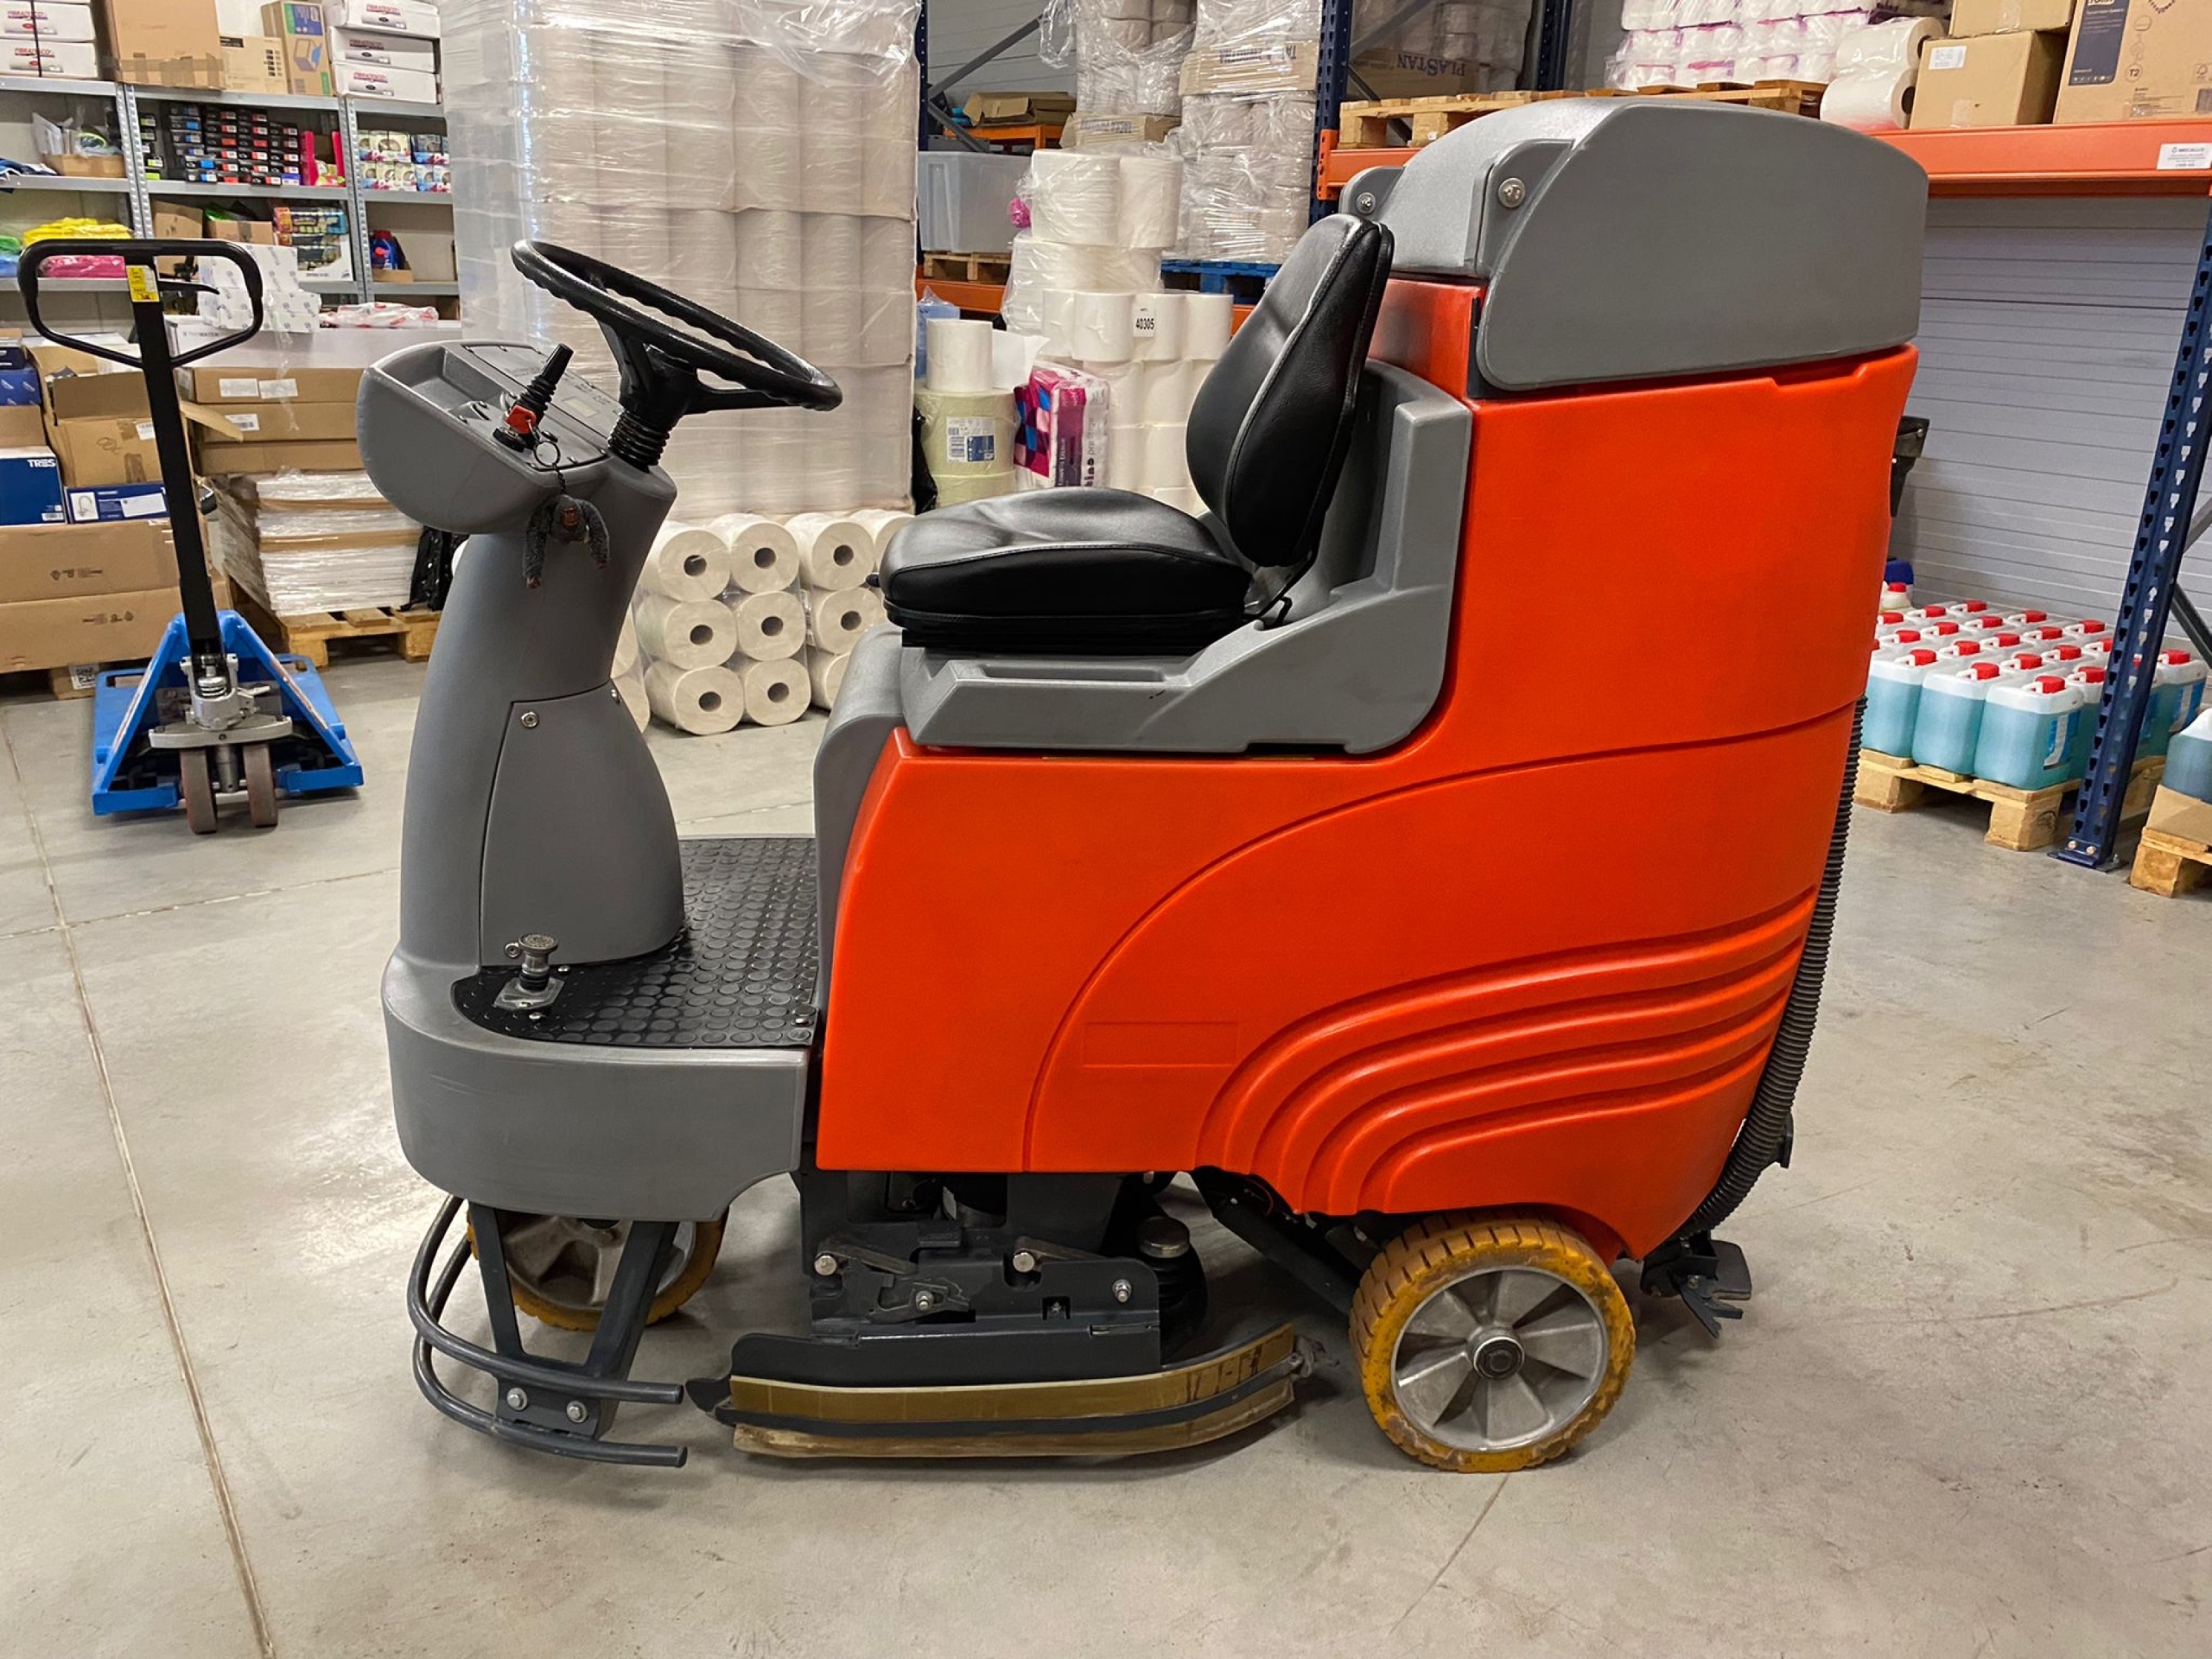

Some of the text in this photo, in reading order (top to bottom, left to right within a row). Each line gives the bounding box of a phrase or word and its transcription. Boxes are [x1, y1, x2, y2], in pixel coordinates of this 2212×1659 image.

[1396, 54, 1466, 77] PLASTAN
[2129, 68, 2140, 77] T2
[1135, 317, 1154, 330] 40305
[27, 459, 56, 467] TRES
